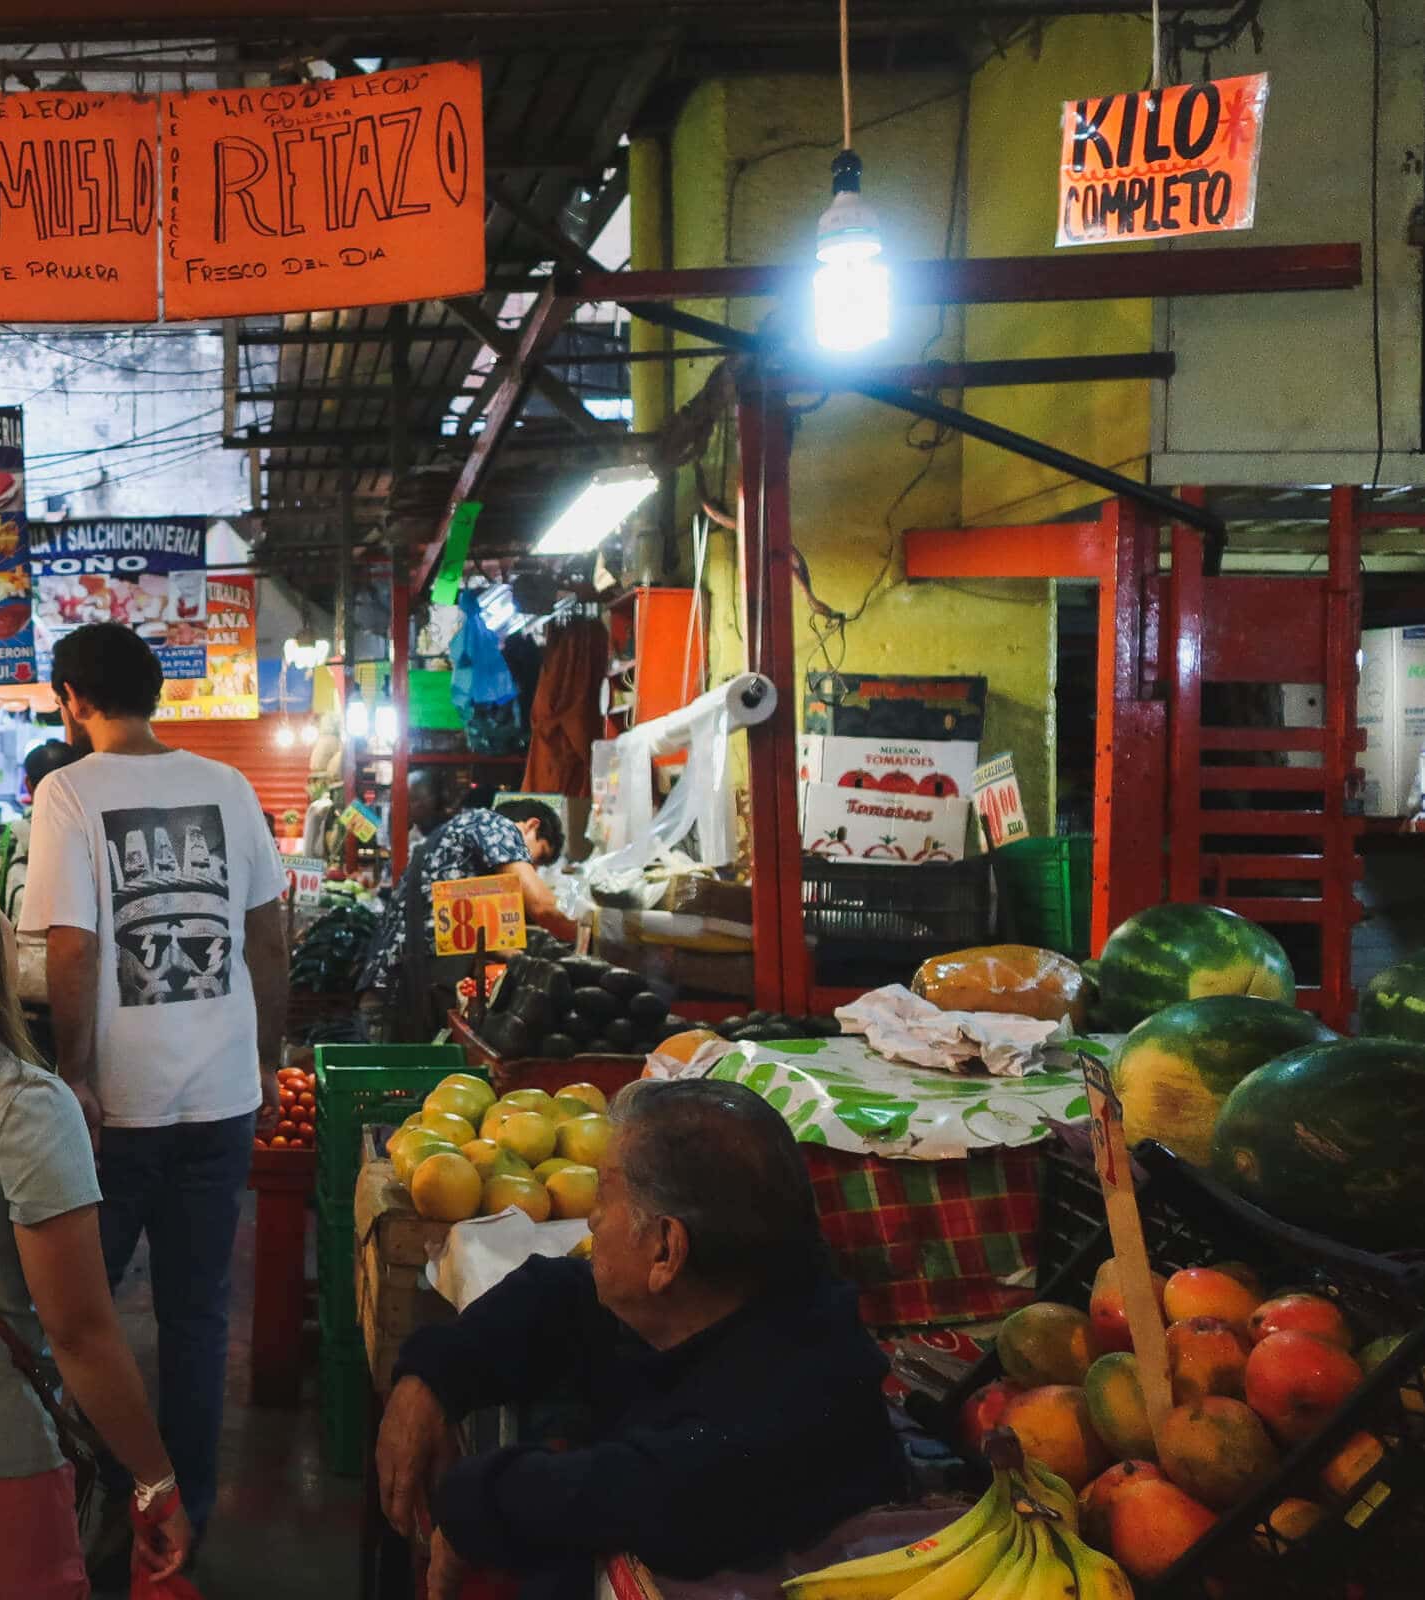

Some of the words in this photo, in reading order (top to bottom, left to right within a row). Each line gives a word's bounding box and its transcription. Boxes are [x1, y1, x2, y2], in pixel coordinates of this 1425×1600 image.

[1072, 84, 1221, 173] KILO
[214, 101, 468, 244] RETAZO
[1064, 168, 1232, 241] COMPLETO
[186, 257, 267, 284] FRESCO
[282, 257, 330, 275] DEL
[339, 247, 386, 267] DIA
[67, 523, 201, 557] SALCHICHONERIA
[30, 554, 148, 574] TOÑO
[865, 753, 934, 766] TOMATOES
[879, 746, 920, 754] MEXICAN
[846, 798, 934, 822] Tomatoes
